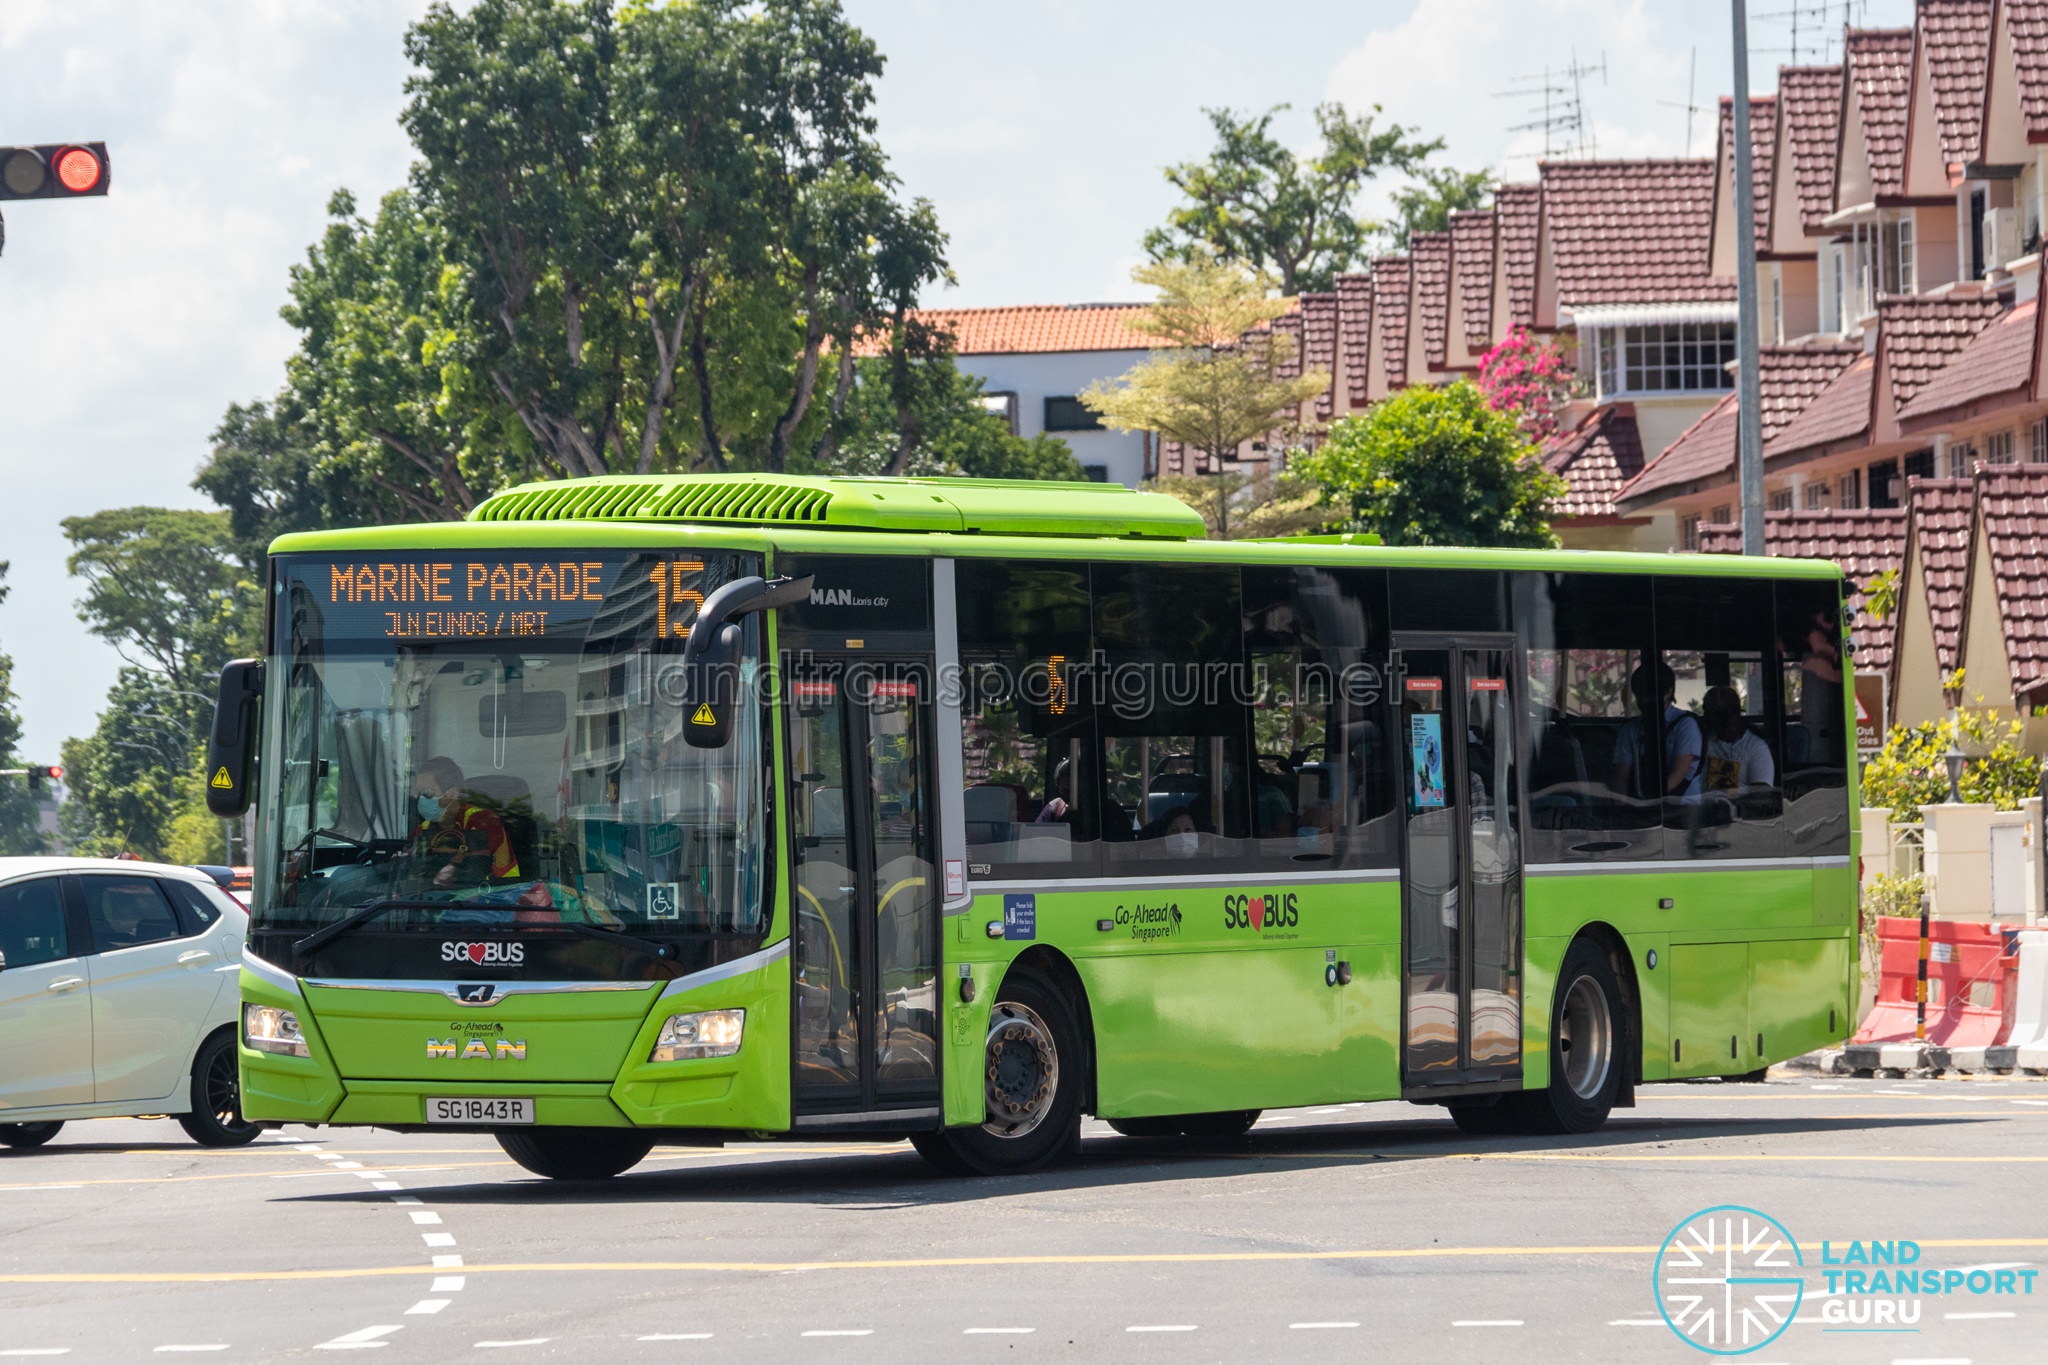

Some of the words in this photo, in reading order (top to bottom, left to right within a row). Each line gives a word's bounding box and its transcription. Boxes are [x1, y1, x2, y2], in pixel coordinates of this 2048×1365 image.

[331, 563, 453, 602] MARINE
[467, 562, 603, 601] PARADE
[649, 561, 704, 638] 15
[810, 588, 852, 606] MAN
[873, 597, 889, 608] City
[385, 612, 420, 636] JLN
[426, 612, 488, 636] EUNOS
[511, 611, 548, 636] MRT
[1856, 726, 1874, 736] Out
[1115, 903, 1168, 925] Go-Ahead
[1131, 925, 1170, 942] Singapore
[450, 1022, 494, 1031] Go-Ahead
[426, 1037, 527, 1060] MAN
[437, 1100, 523, 1120] SG1843R
